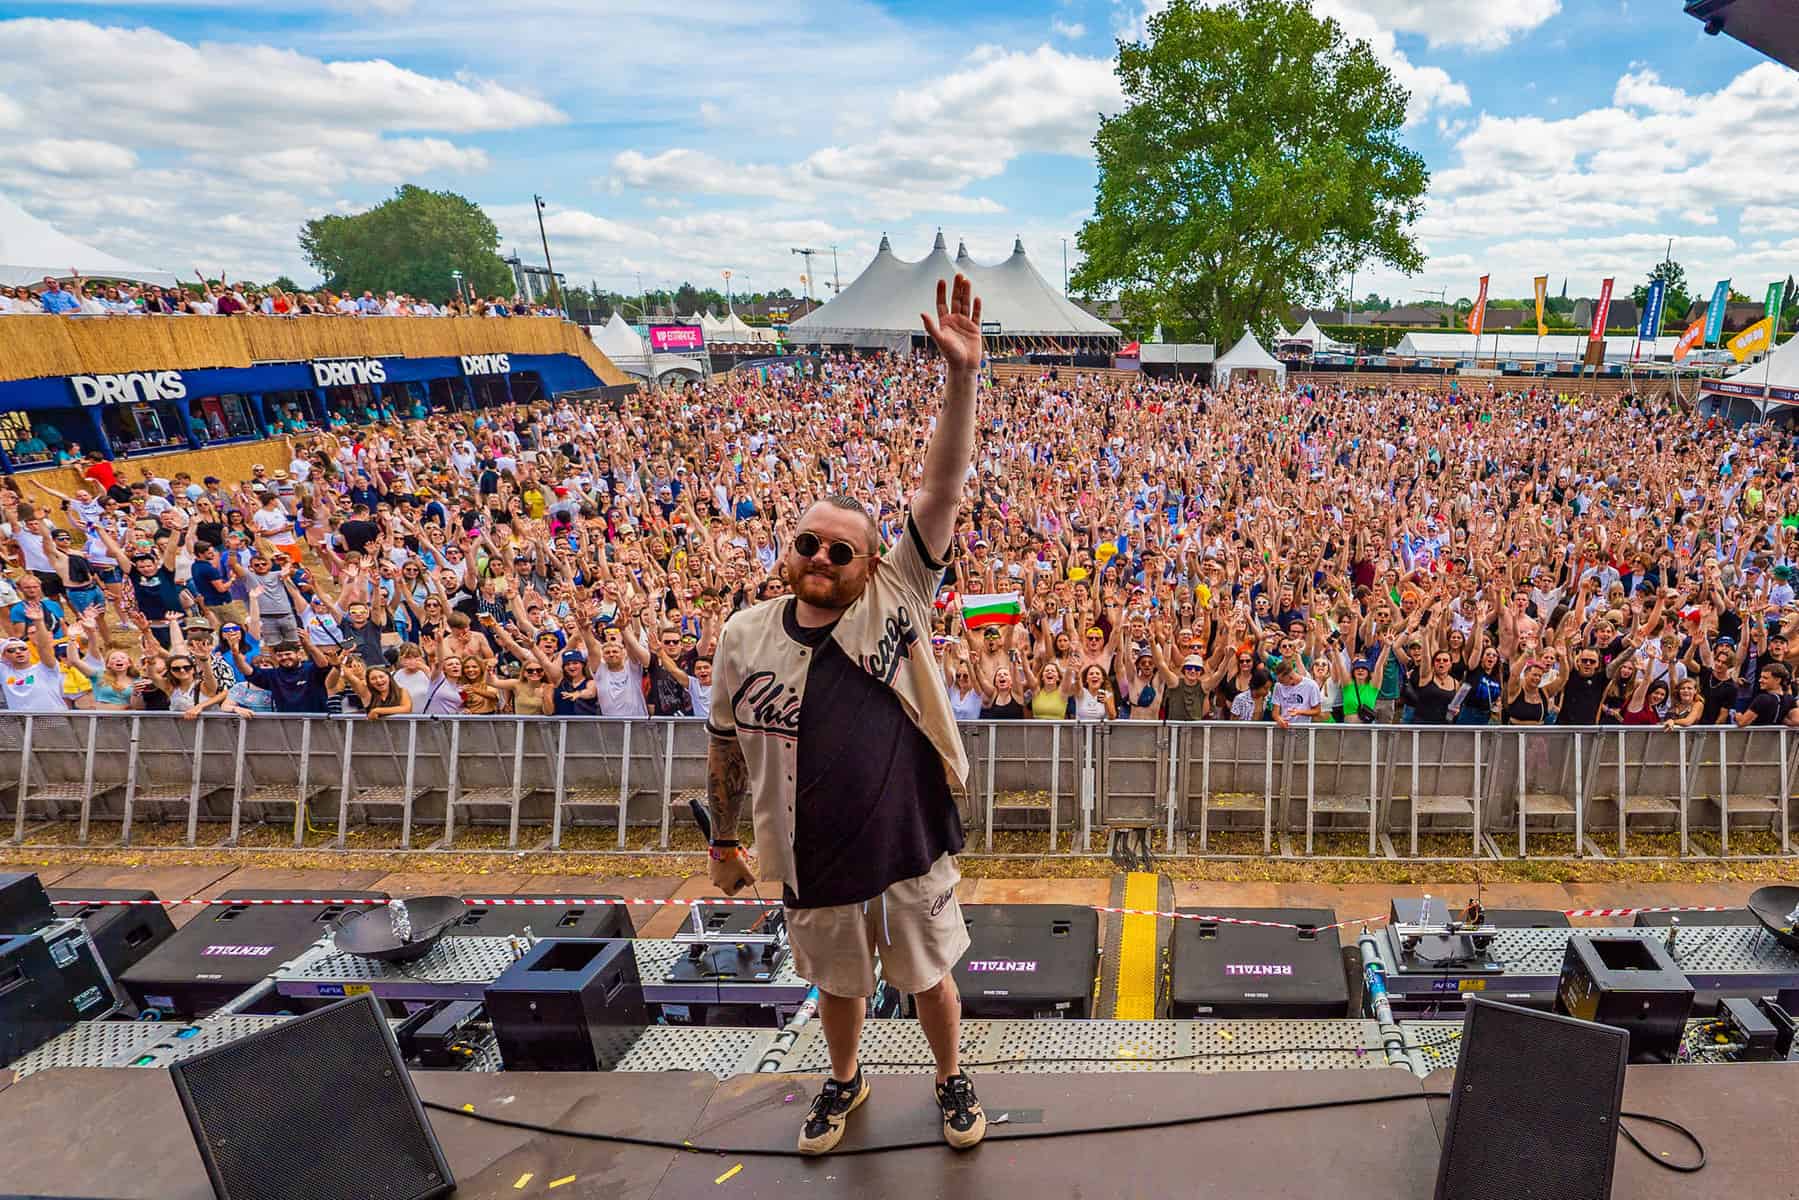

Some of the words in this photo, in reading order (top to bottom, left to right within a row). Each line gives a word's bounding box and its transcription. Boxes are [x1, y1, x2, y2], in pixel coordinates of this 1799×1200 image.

[461, 354, 511, 376] DRINKS
[313, 360, 387, 387] DRINKS
[71, 371, 187, 406] DRINKS
[205, 945, 275, 956] RENTALL
[969, 960, 1037, 971] RENTALL
[1225, 964, 1293, 975] RENTALL
